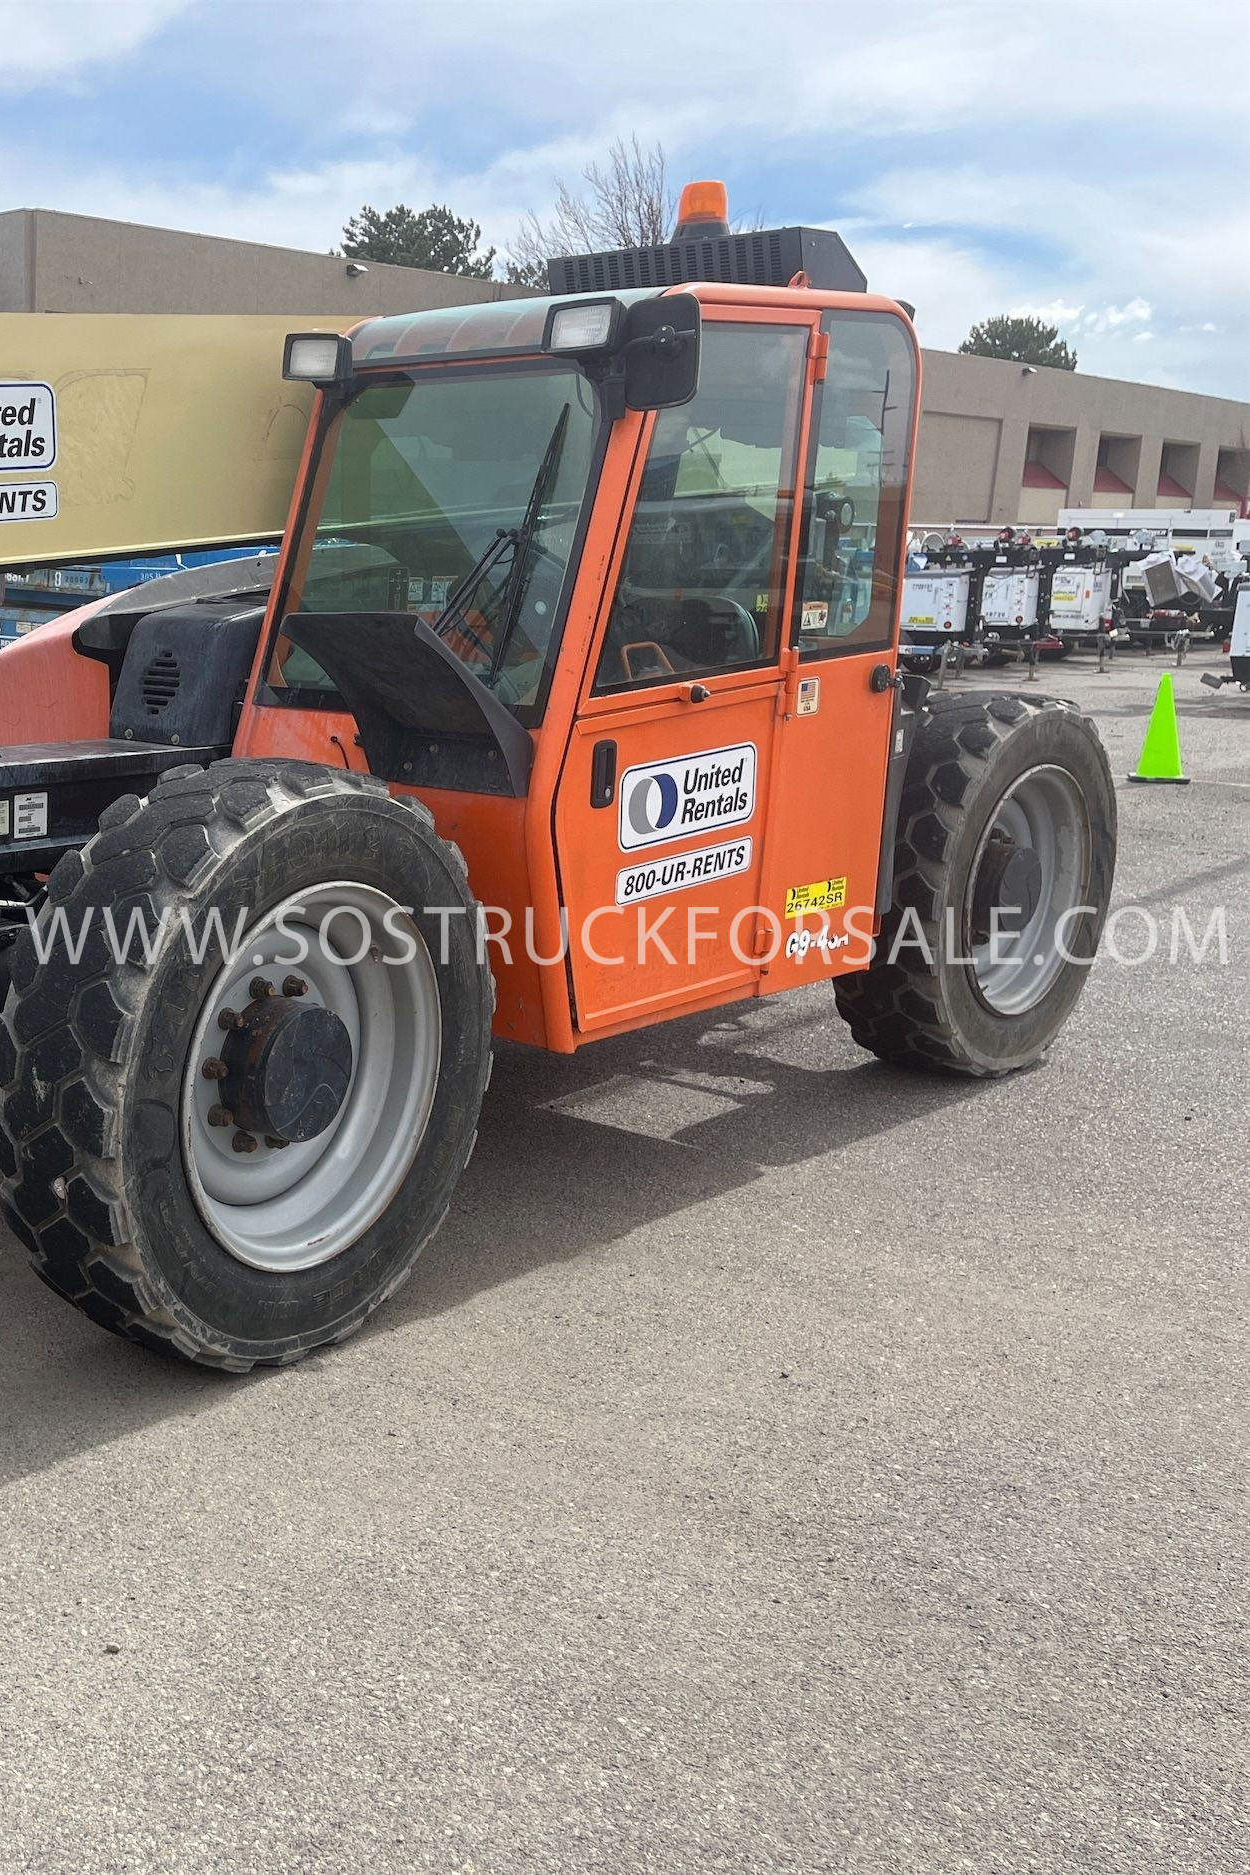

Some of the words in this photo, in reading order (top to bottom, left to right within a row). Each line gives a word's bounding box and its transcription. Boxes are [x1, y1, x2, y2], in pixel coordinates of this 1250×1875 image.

[684, 757, 745, 795] United
[681, 787, 748, 825] Rentals
[624, 845, 745, 897] 800-UR-RENTS
[786, 891, 843, 914] 26742SR
